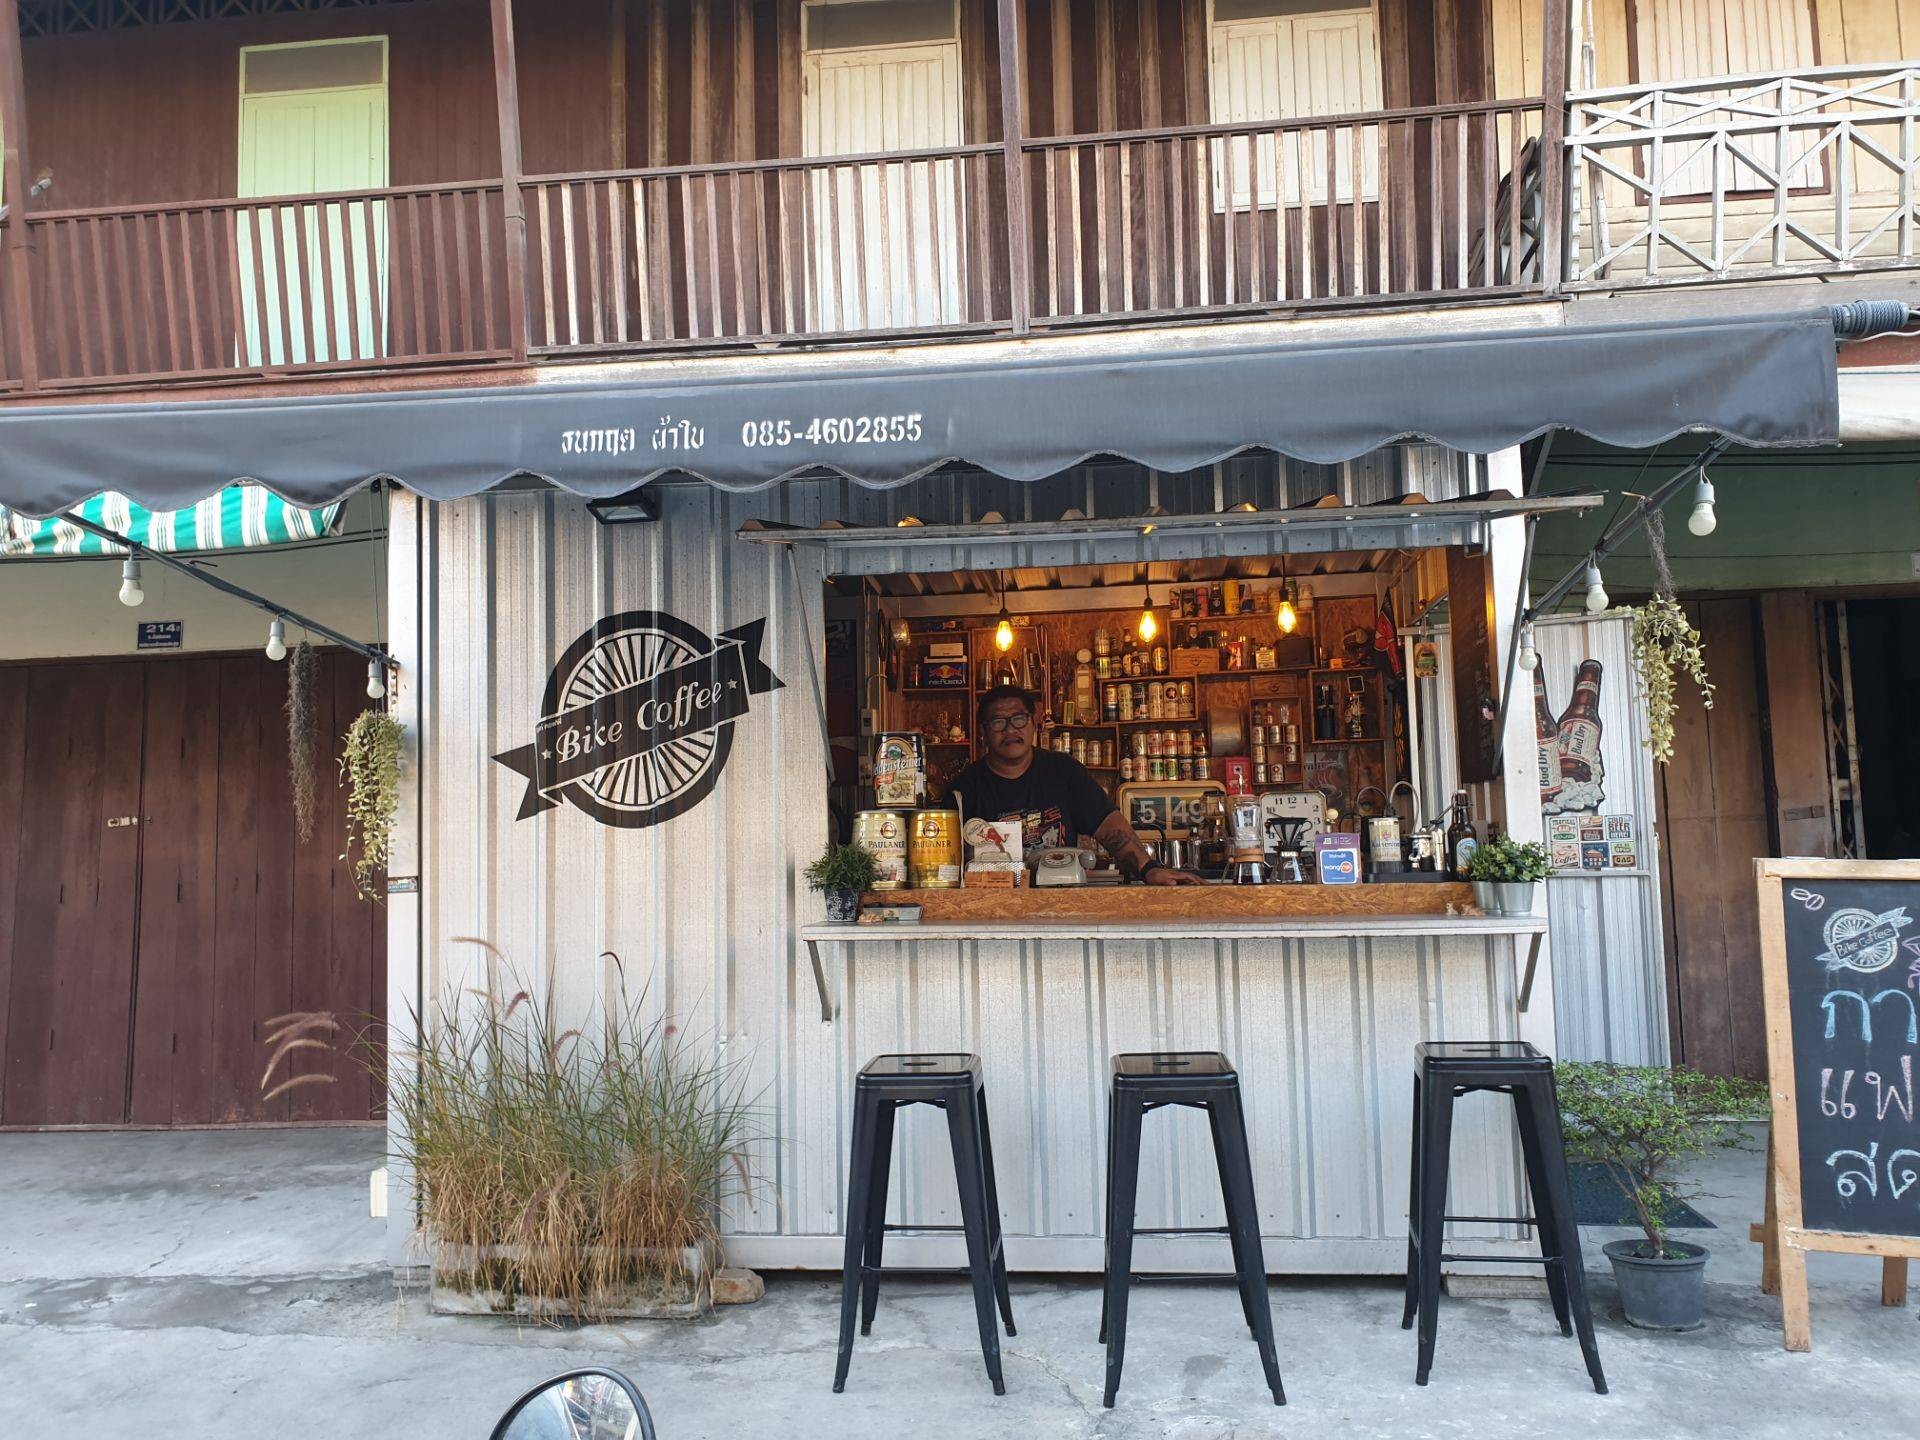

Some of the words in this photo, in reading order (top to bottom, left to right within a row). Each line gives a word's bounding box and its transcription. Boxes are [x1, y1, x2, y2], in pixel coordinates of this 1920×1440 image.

[652, 414, 705, 451] ผ้าใบ
[741, 413, 923, 447] 085-4602855
[556, 718, 624, 764] Bike
[637, 680, 723, 732] Coffee
[1288, 796, 1297, 804] 12
[1139, 801, 1157, 824] 5
[1608, 823, 1631, 832] BEER
[912, 840, 952, 849] PAULANER
[1837, 937, 1860, 958] Bike
[1859, 925, 1893, 949] Coffee
